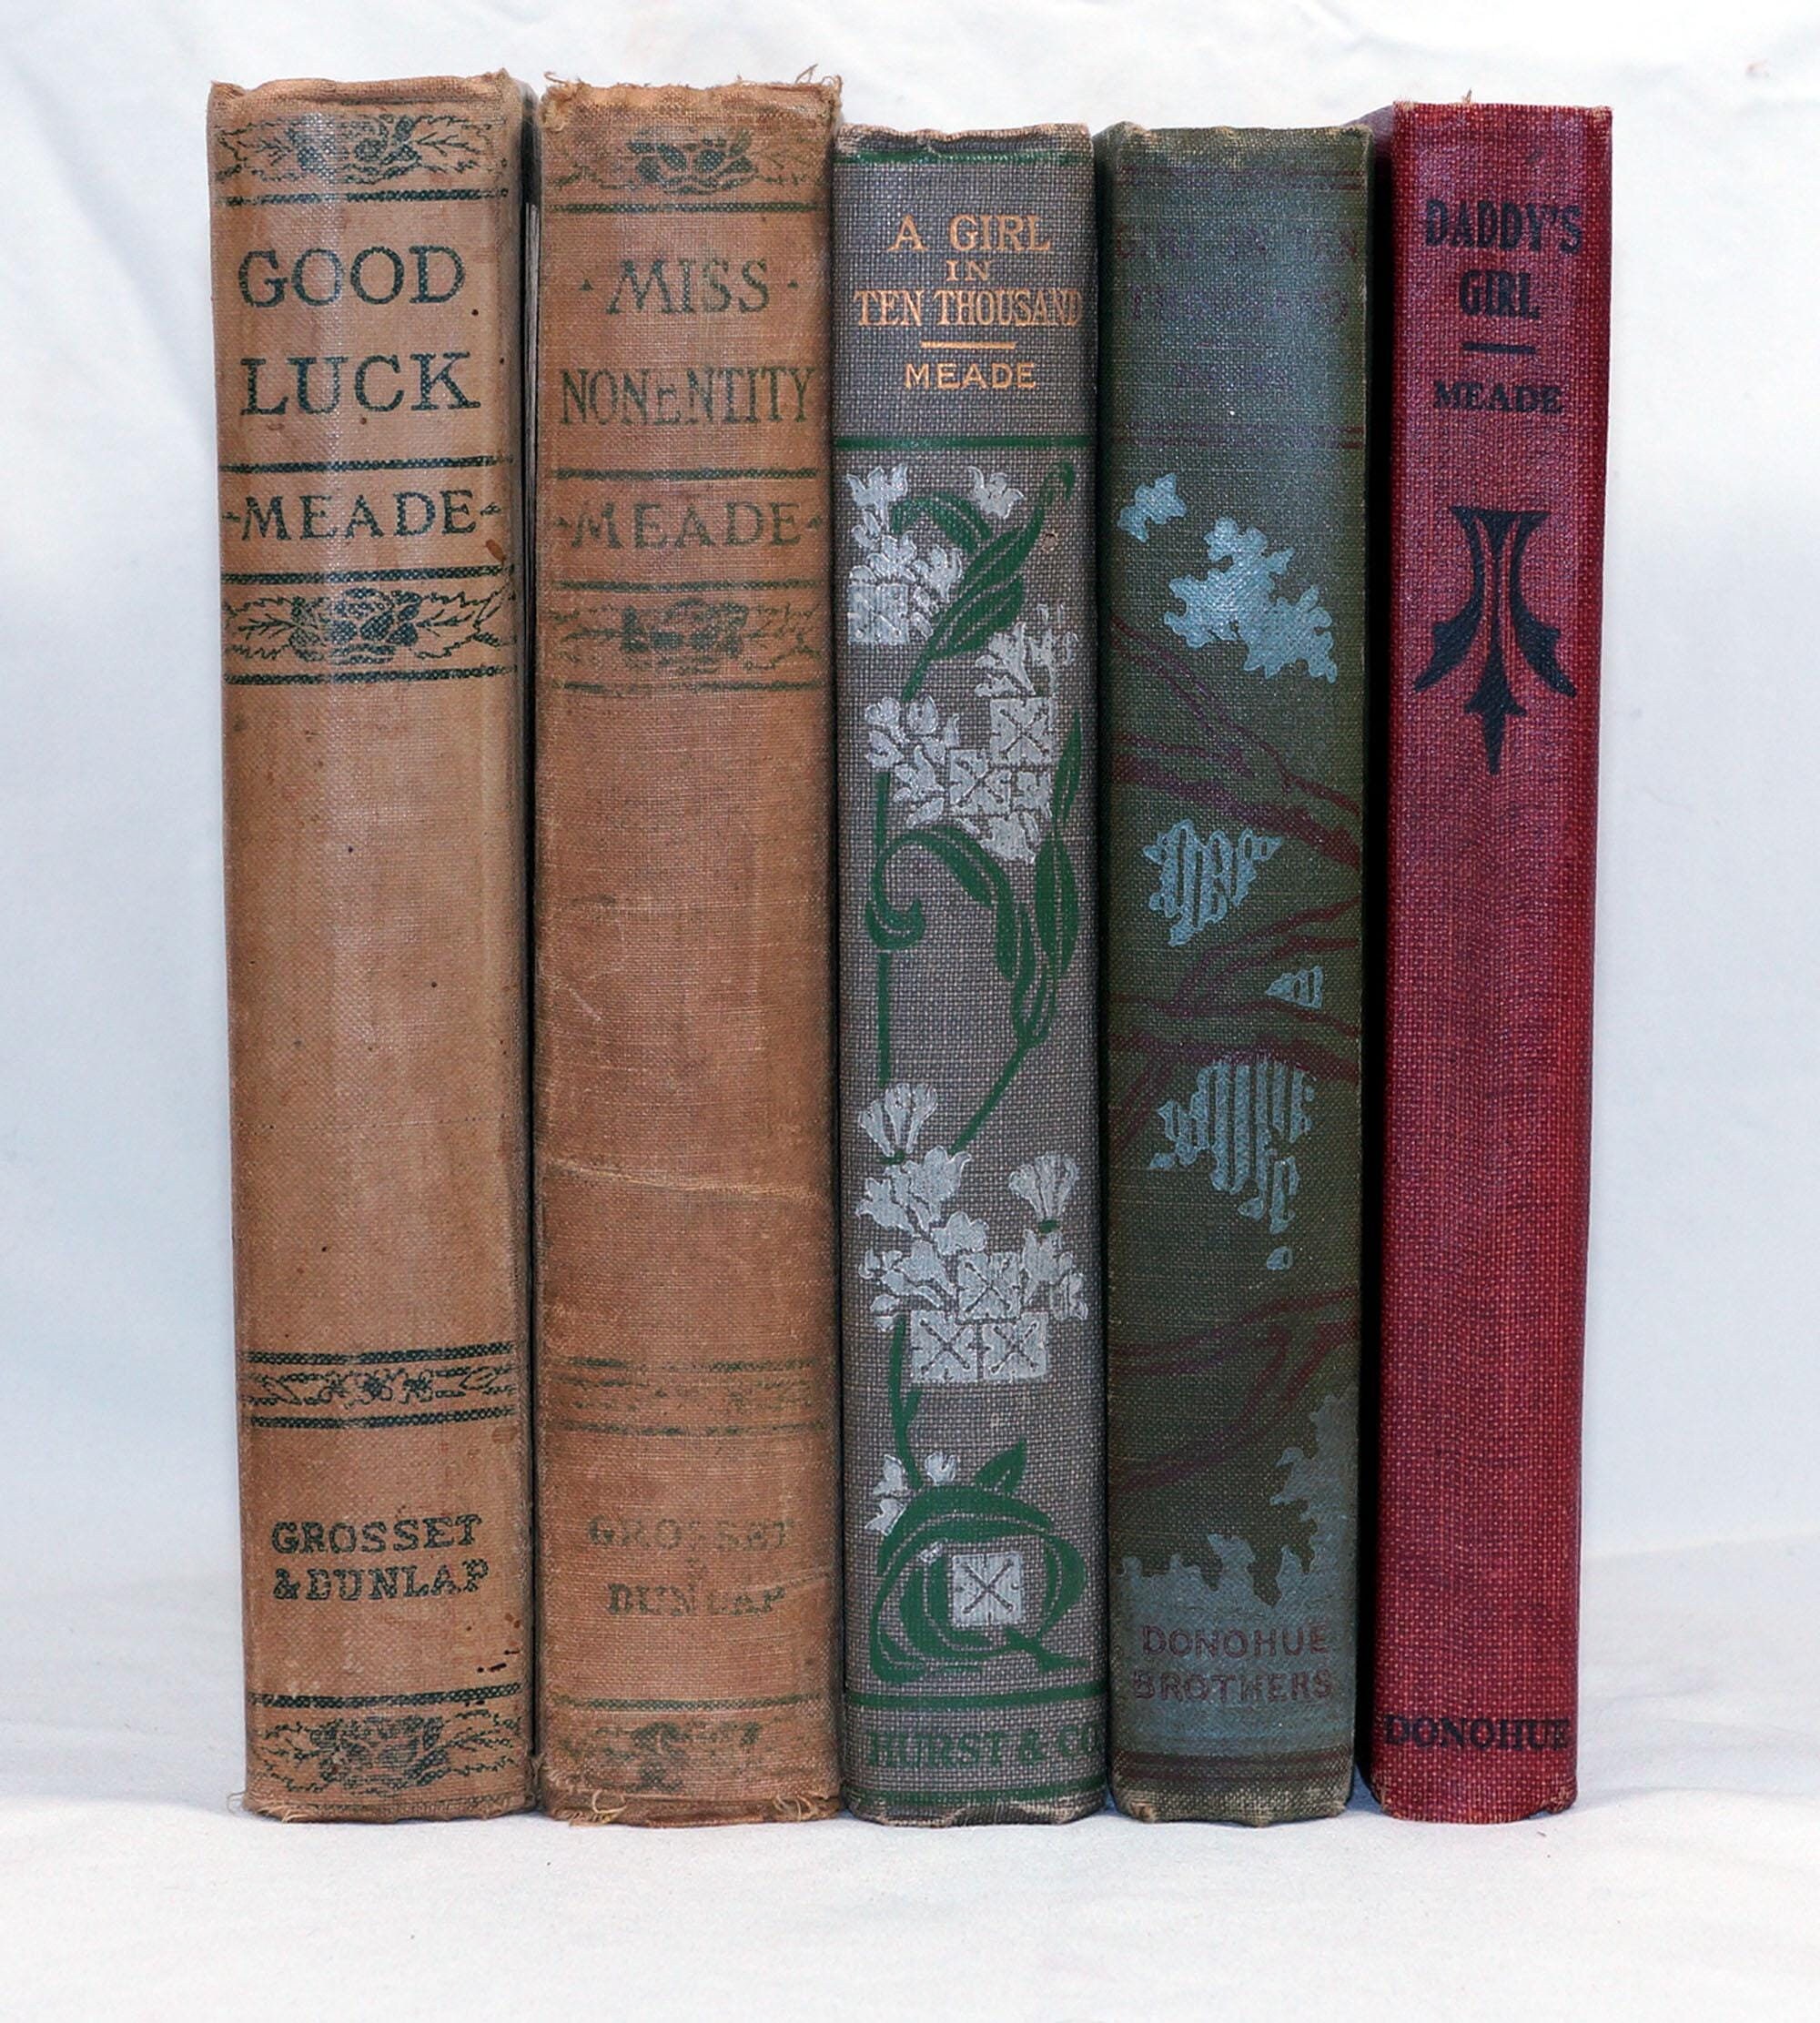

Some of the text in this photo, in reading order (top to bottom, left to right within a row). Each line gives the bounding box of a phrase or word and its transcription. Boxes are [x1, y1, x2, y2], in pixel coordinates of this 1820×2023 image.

[888, 214, 1051, 251] A GIRL
[1425, 199, 1582, 255] DADDY'S
[238, 245, 466, 308] GOOD
[606, 258, 771, 314] MISS
[945, 260, 993, 281] IN
[854, 288, 924, 327] TEN
[933, 288, 1083, 327] THOUSAND
[1460, 270, 1540, 319] GIRL
[241, 351, 481, 416] LUCK
[560, 366, 816, 425] NONENTITY
[905, 362, 1036, 390] MEADE
[1433, 379, 1563, 415] MEADE
[242, 491, 478, 541] MEADE
[571, 502, 802, 549] MEADE
[272, 1513, 483, 1554] GROSSET
[1142, 1623, 1328, 1658] DONOHUE
[1134, 1668, 1333, 1704] BROTHERS
[867, 1731, 1007, 1770] HURST
[1017, 1729, 1046, 1765] &
[1384, 1714, 1570, 1751] DONOHUE
